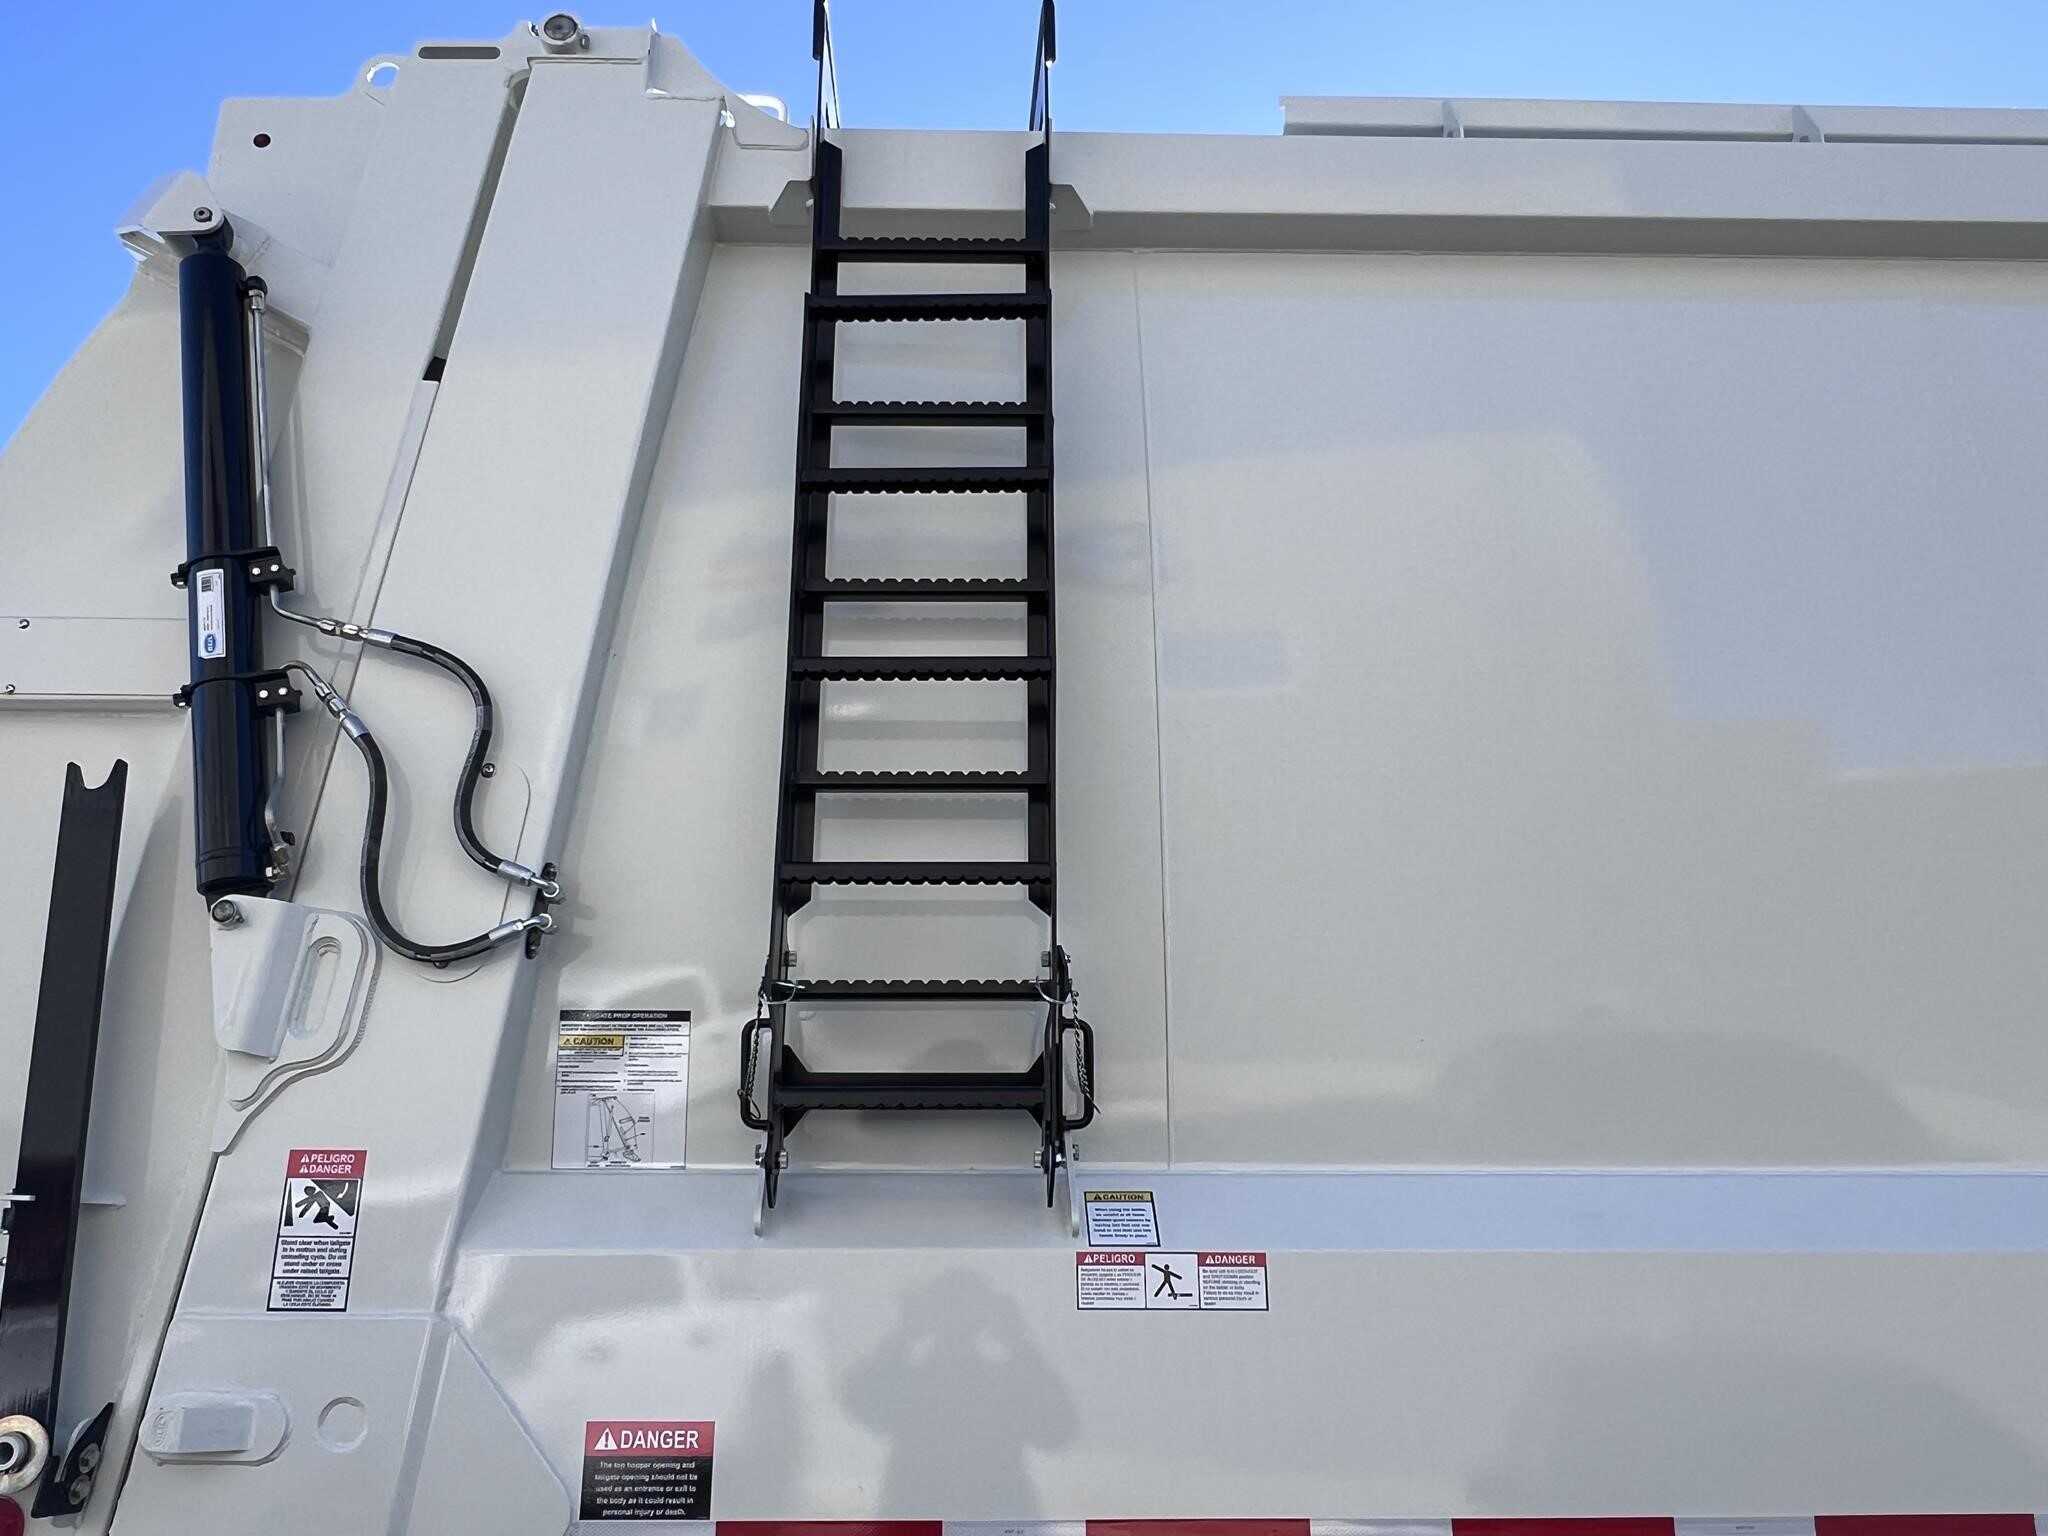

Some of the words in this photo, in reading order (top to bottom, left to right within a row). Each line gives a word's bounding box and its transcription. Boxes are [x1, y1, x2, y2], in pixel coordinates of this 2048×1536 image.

[573, 1037, 615, 1046] CAUTION
[310, 1154, 355, 1164] PELIGRO
[309, 1165, 352, 1174] DANGER
[1093, 1254, 1136, 1264] PELIGRO
[1214, 1255, 1256, 1264] DANGER
[620, 1430, 699, 1449] DANGER
[652, 1461, 681, 1470] opening
[621, 1474, 650, 1482] opening
[609, 1497, 627, 1506] body
[602, 1508, 633, 1517] personal
[634, 1508, 655, 1517] injury
